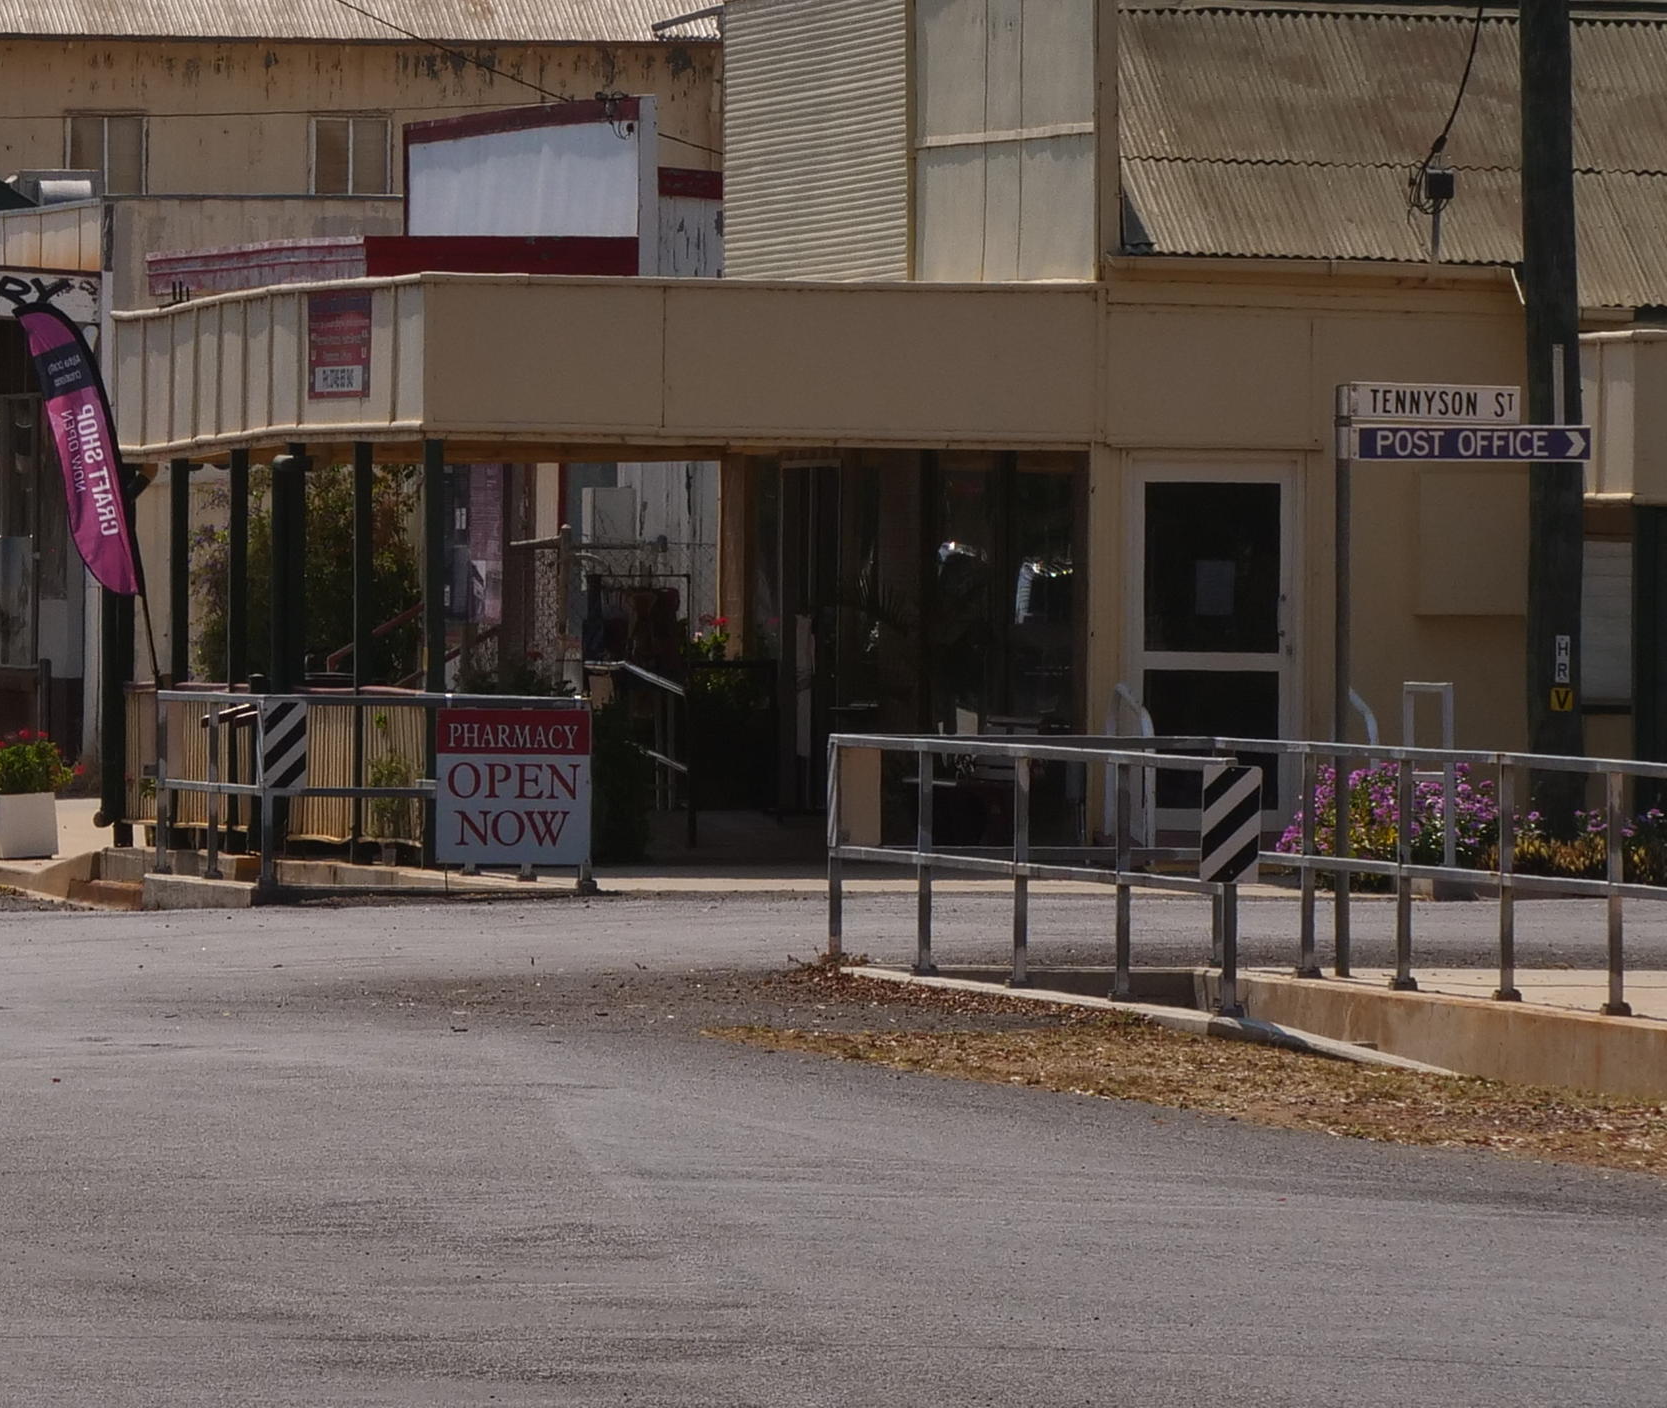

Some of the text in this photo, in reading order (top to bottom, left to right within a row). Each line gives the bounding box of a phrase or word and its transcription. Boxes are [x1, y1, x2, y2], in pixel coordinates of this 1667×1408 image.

[1370, 389, 1515, 418] TENNYSON ST
[1376, 430, 1549, 457] POST OFFICE
[1554, 689, 1572, 710] V
[448, 723, 579, 749] PHARMACY
[447, 762, 581, 800] OPEN
[454, 809, 571, 847] NOW
